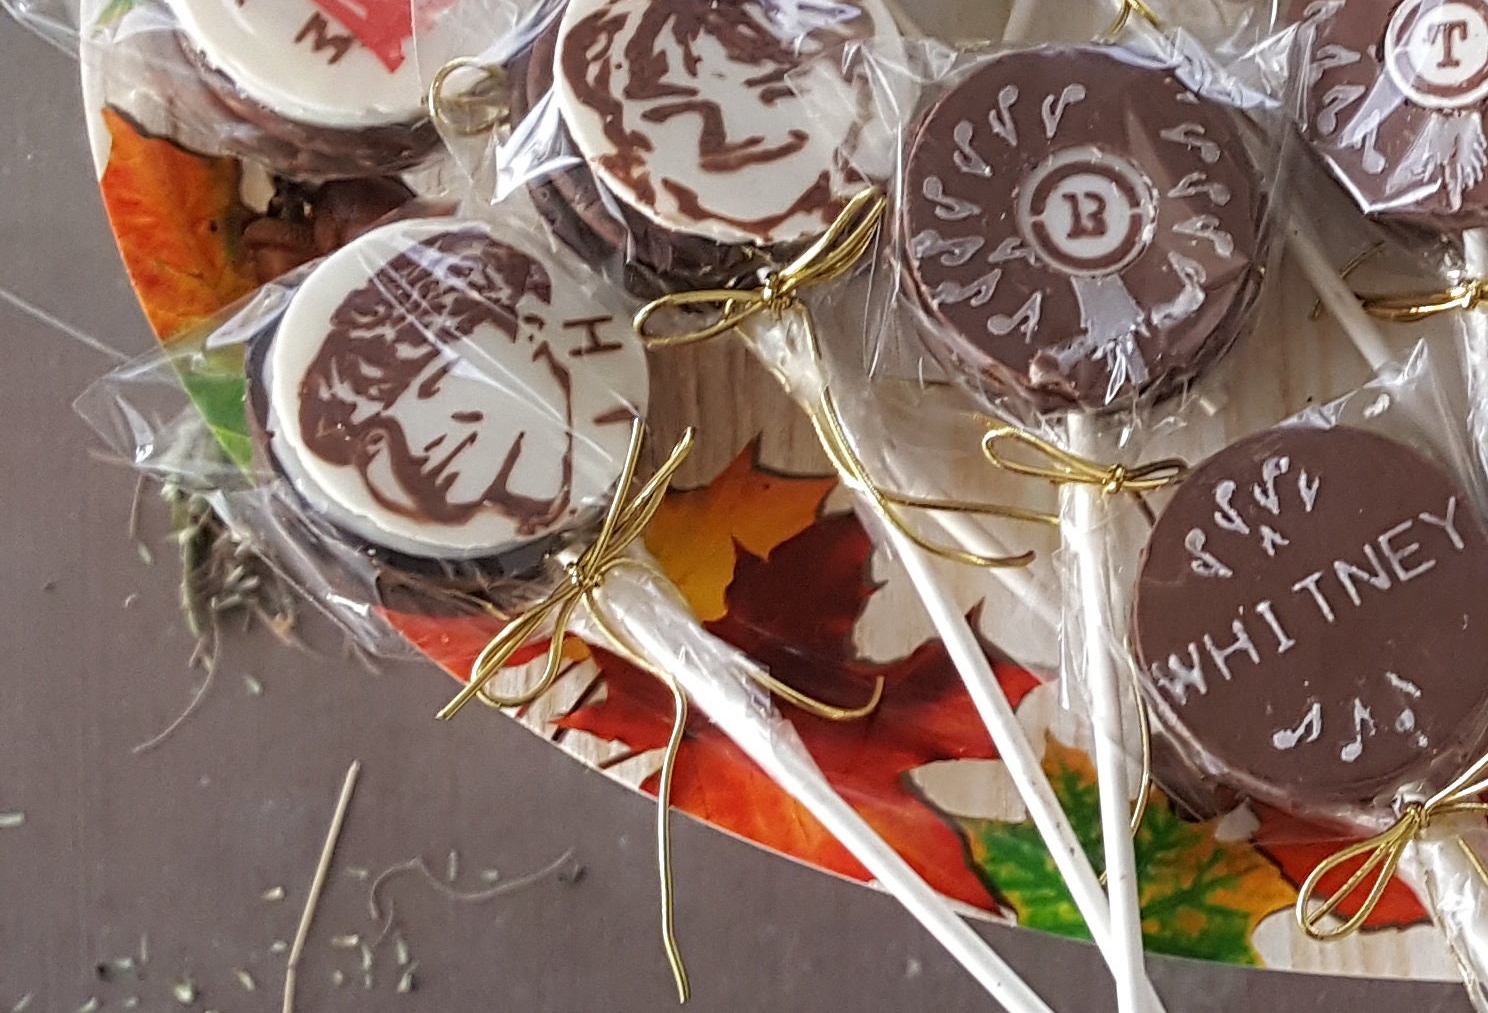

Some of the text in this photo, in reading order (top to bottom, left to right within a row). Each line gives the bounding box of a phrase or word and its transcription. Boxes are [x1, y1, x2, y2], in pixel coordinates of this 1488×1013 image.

[1426, 18, 1470, 70] T
[1060, 191, 1108, 240] B
[1150, 485, 1466, 707] WHITNEY
